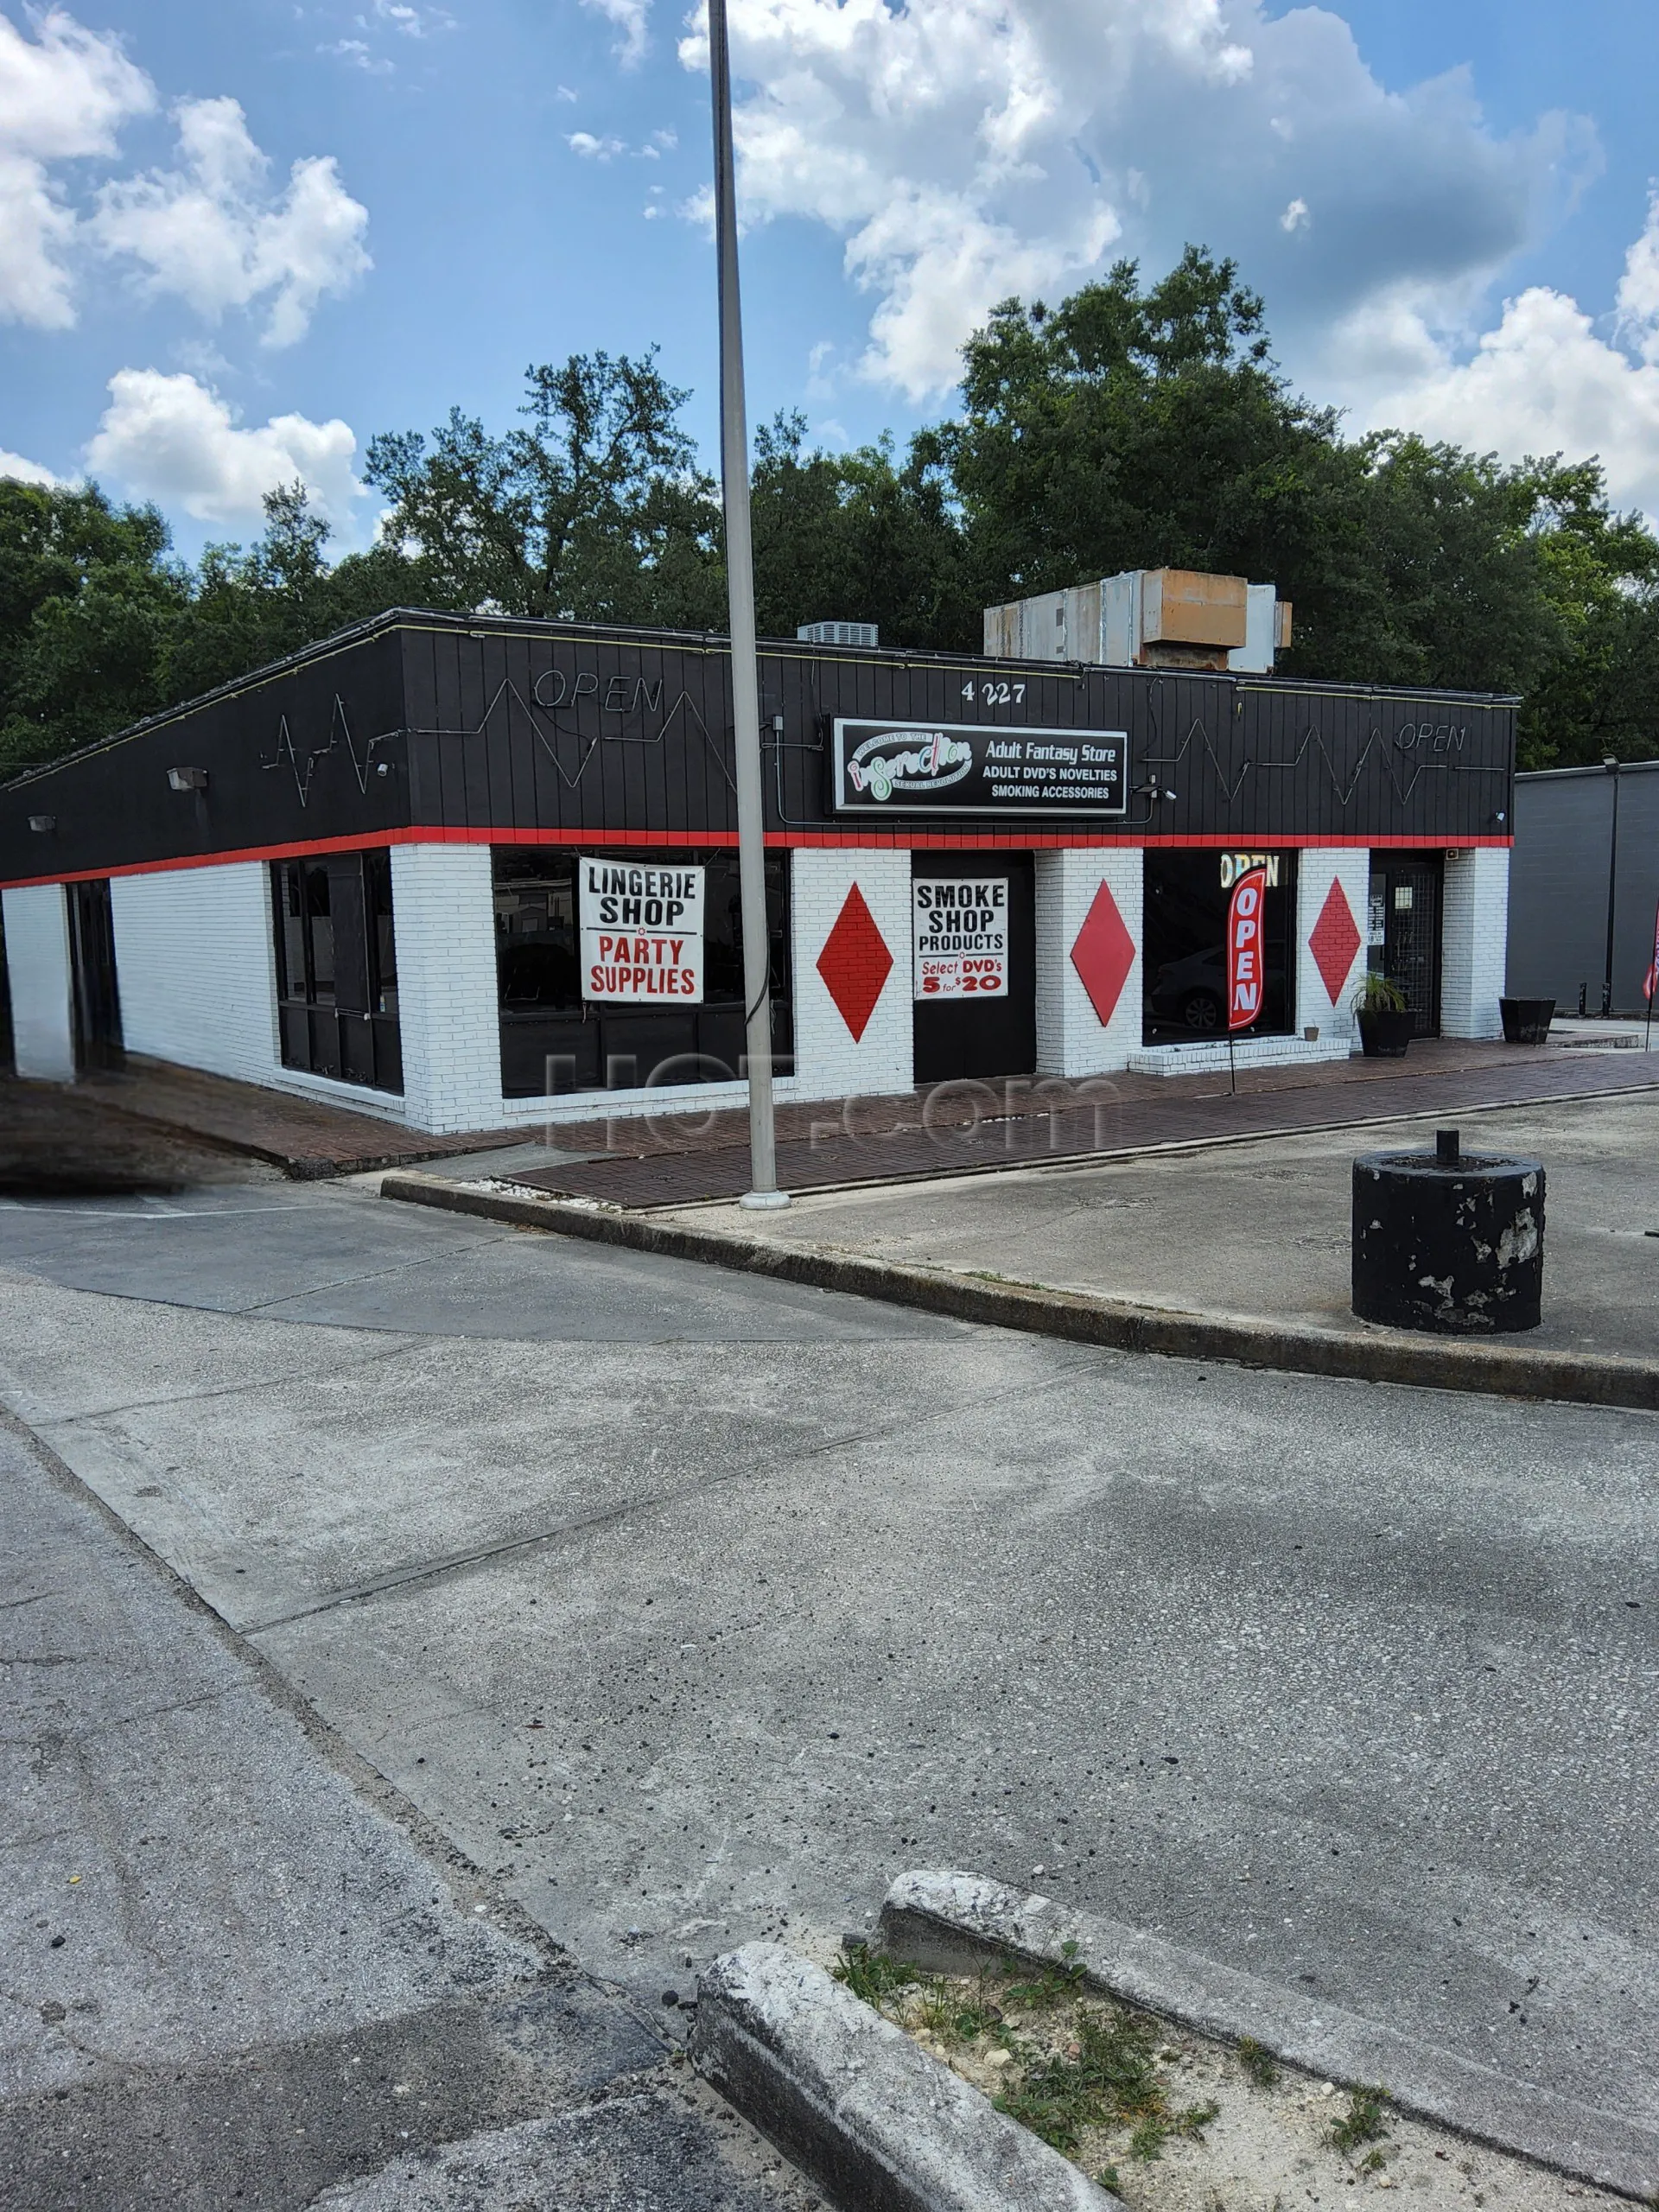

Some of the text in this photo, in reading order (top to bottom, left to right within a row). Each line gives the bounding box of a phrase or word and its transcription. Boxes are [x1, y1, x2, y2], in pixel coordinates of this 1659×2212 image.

[534, 670, 663, 712] OPEN
[961, 681, 1026, 706] 4227
[856, 733, 927, 757] WELCOME TO THE
[1399, 723, 1466, 752] OPEN
[985, 741, 1116, 765] Adult Fantasy Store
[894, 763, 969, 790] SEXUAL REVOLUTION
[982, 766, 1117, 781] ADULT DVD'S NOVELTIES
[992, 785, 1109, 799] SMOKING ACCESSORIES
[588, 866, 696, 899] LINGERIE
[917, 885, 1005, 908] SMOKE
[599, 896, 684, 926] SHOP
[928, 910, 995, 933] SHOP
[599, 936, 684, 965] PARTY
[918, 933, 1003, 951] PRODUCTS
[1233, 887, 1258, 1011] OPEN
[922, 959, 1002, 976] Select DVD's
[590, 965, 696, 995] SUPPLIES
[922, 975, 1001, 993] 5 for $20
